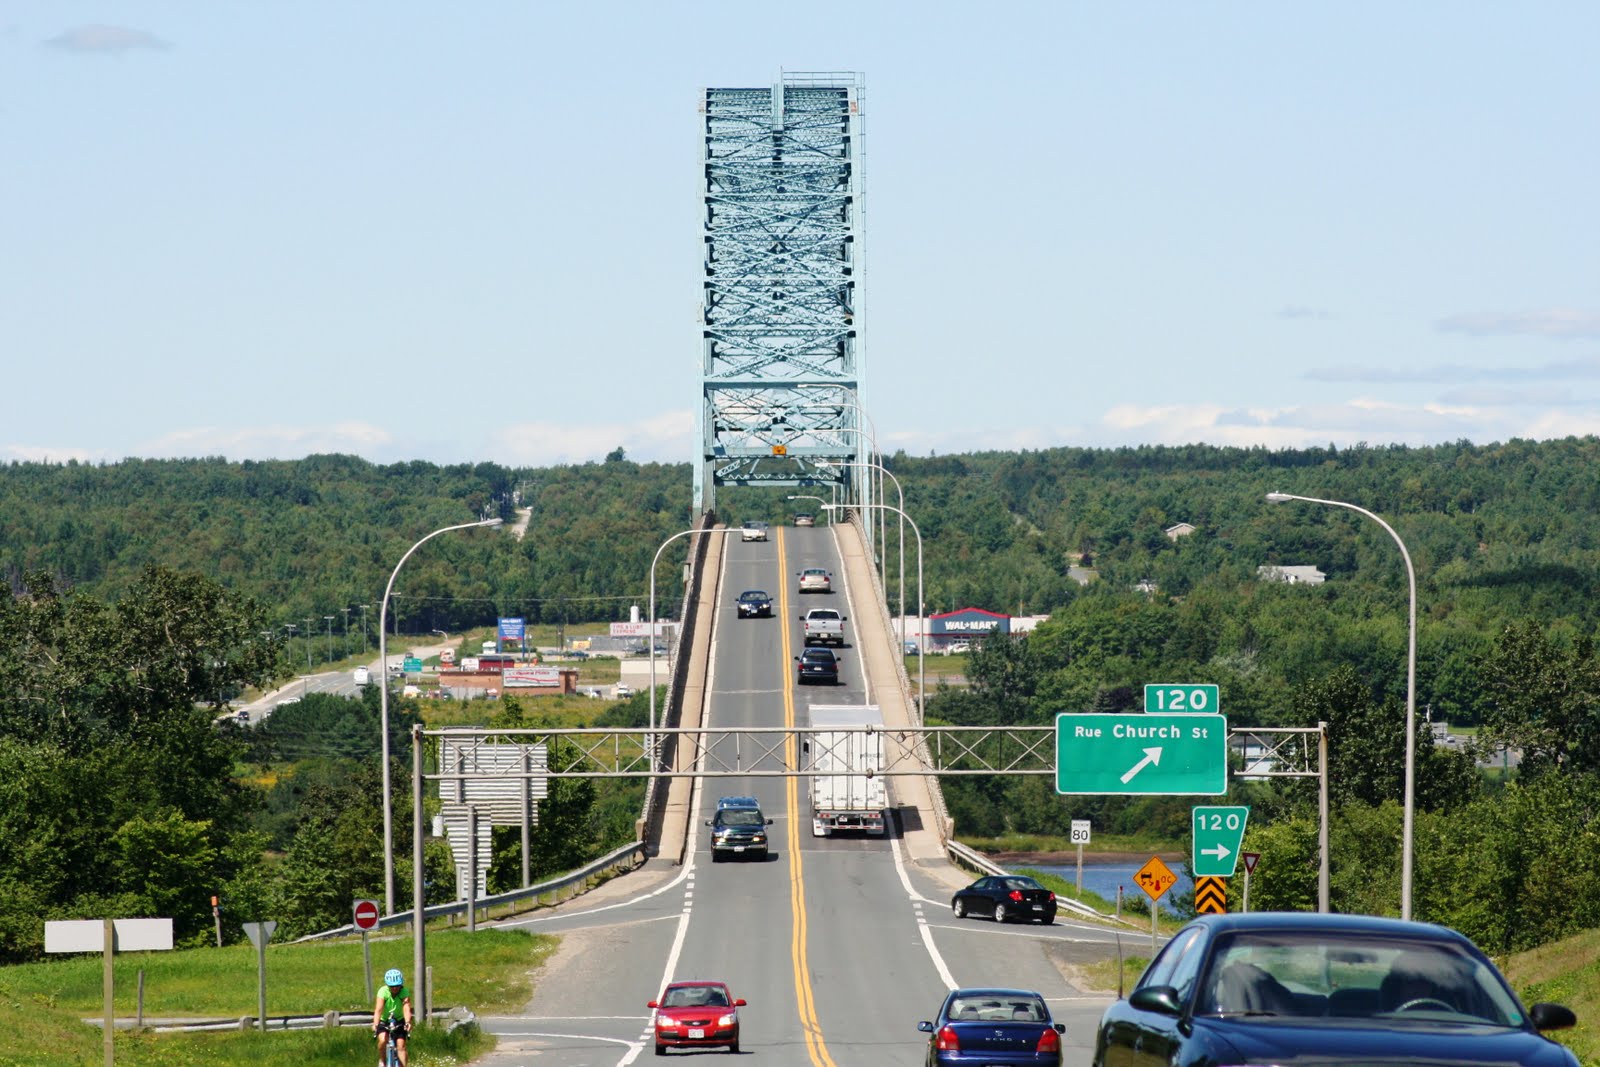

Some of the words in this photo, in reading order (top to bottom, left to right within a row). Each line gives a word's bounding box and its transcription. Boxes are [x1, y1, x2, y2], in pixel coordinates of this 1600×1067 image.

[1156, 689, 1208, 710] 120
[1075, 726, 1102, 738] Rue
[1113, 724, 1181, 738] Church
[1192, 727, 1208, 739] St
[1197, 814, 1240, 830] 120
[1072, 829, 1089, 841] 80
